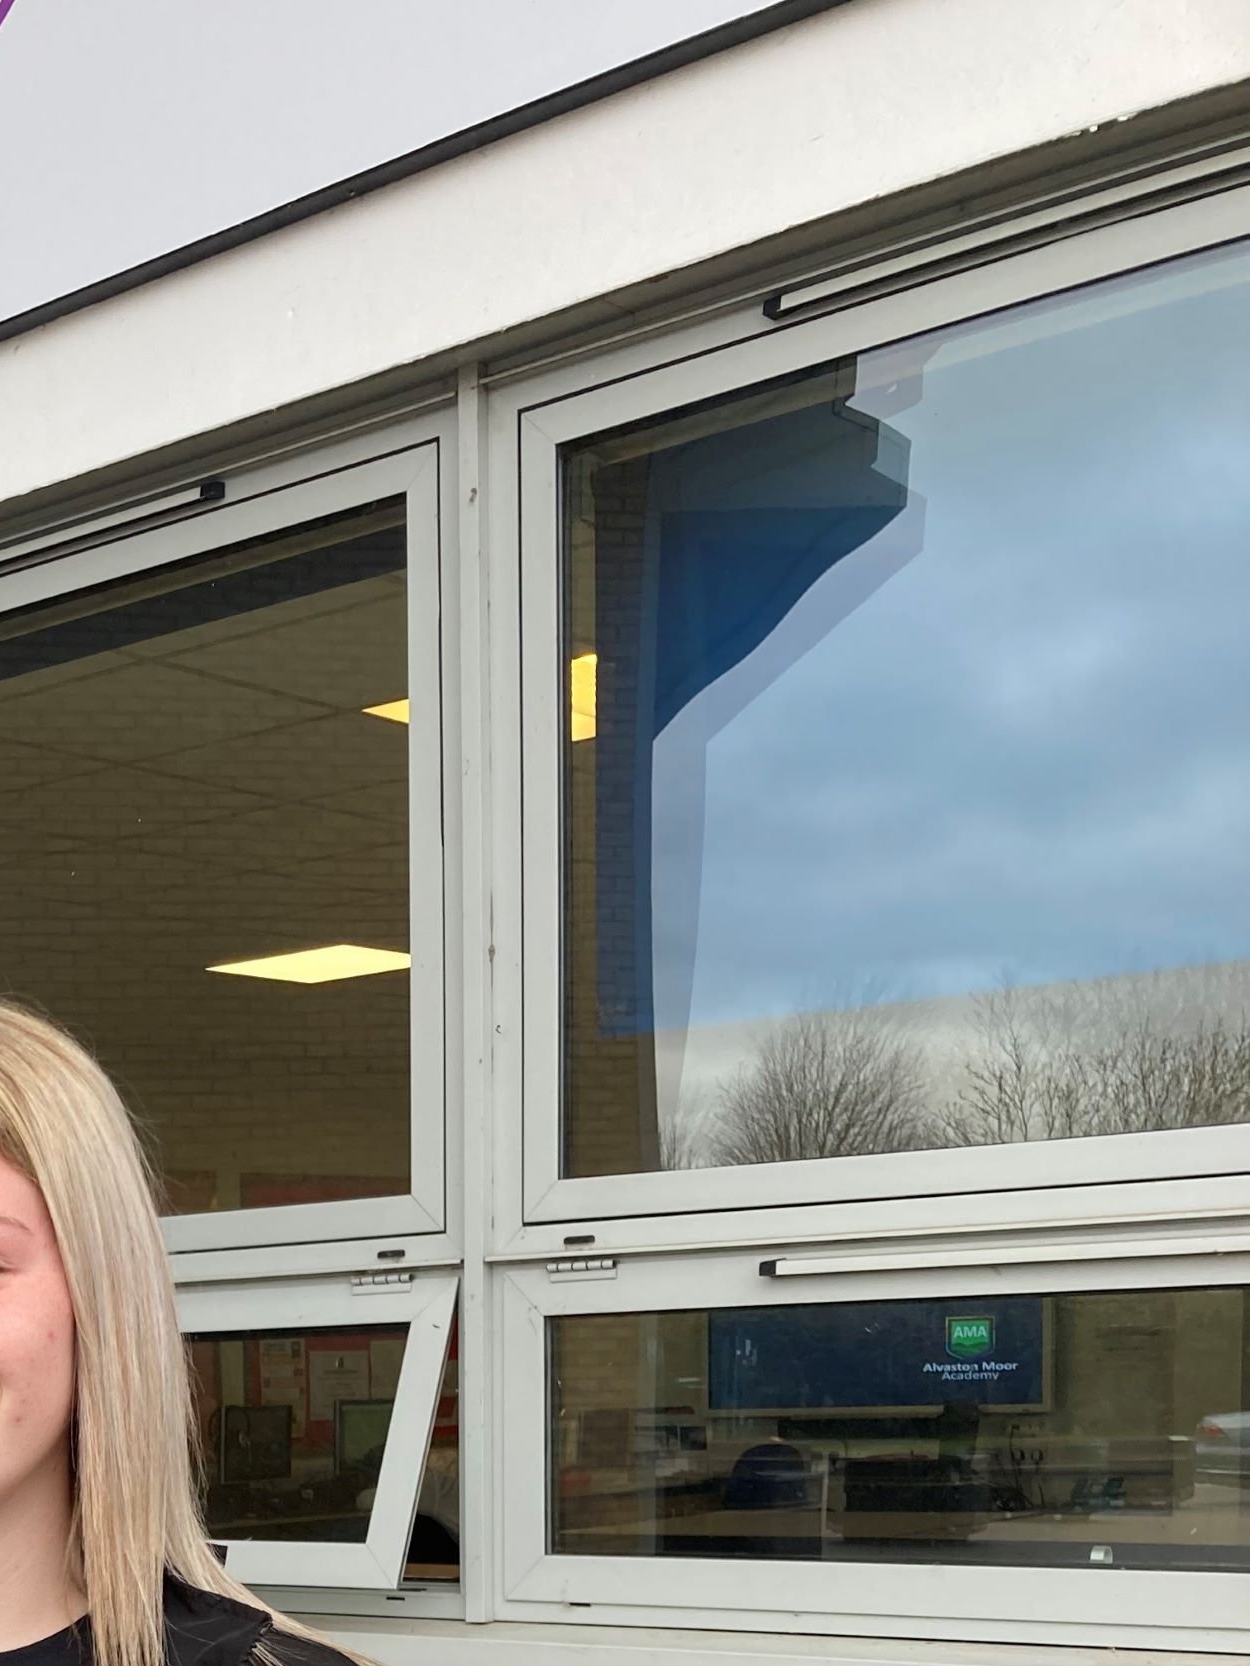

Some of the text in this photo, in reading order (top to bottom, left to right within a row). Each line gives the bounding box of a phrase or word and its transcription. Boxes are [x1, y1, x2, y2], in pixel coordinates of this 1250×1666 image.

[953, 1325, 987, 1338] AMA
[923, 1361, 1019, 1372] Alvaston Moor
[941, 1371, 1000, 1381] Academy
